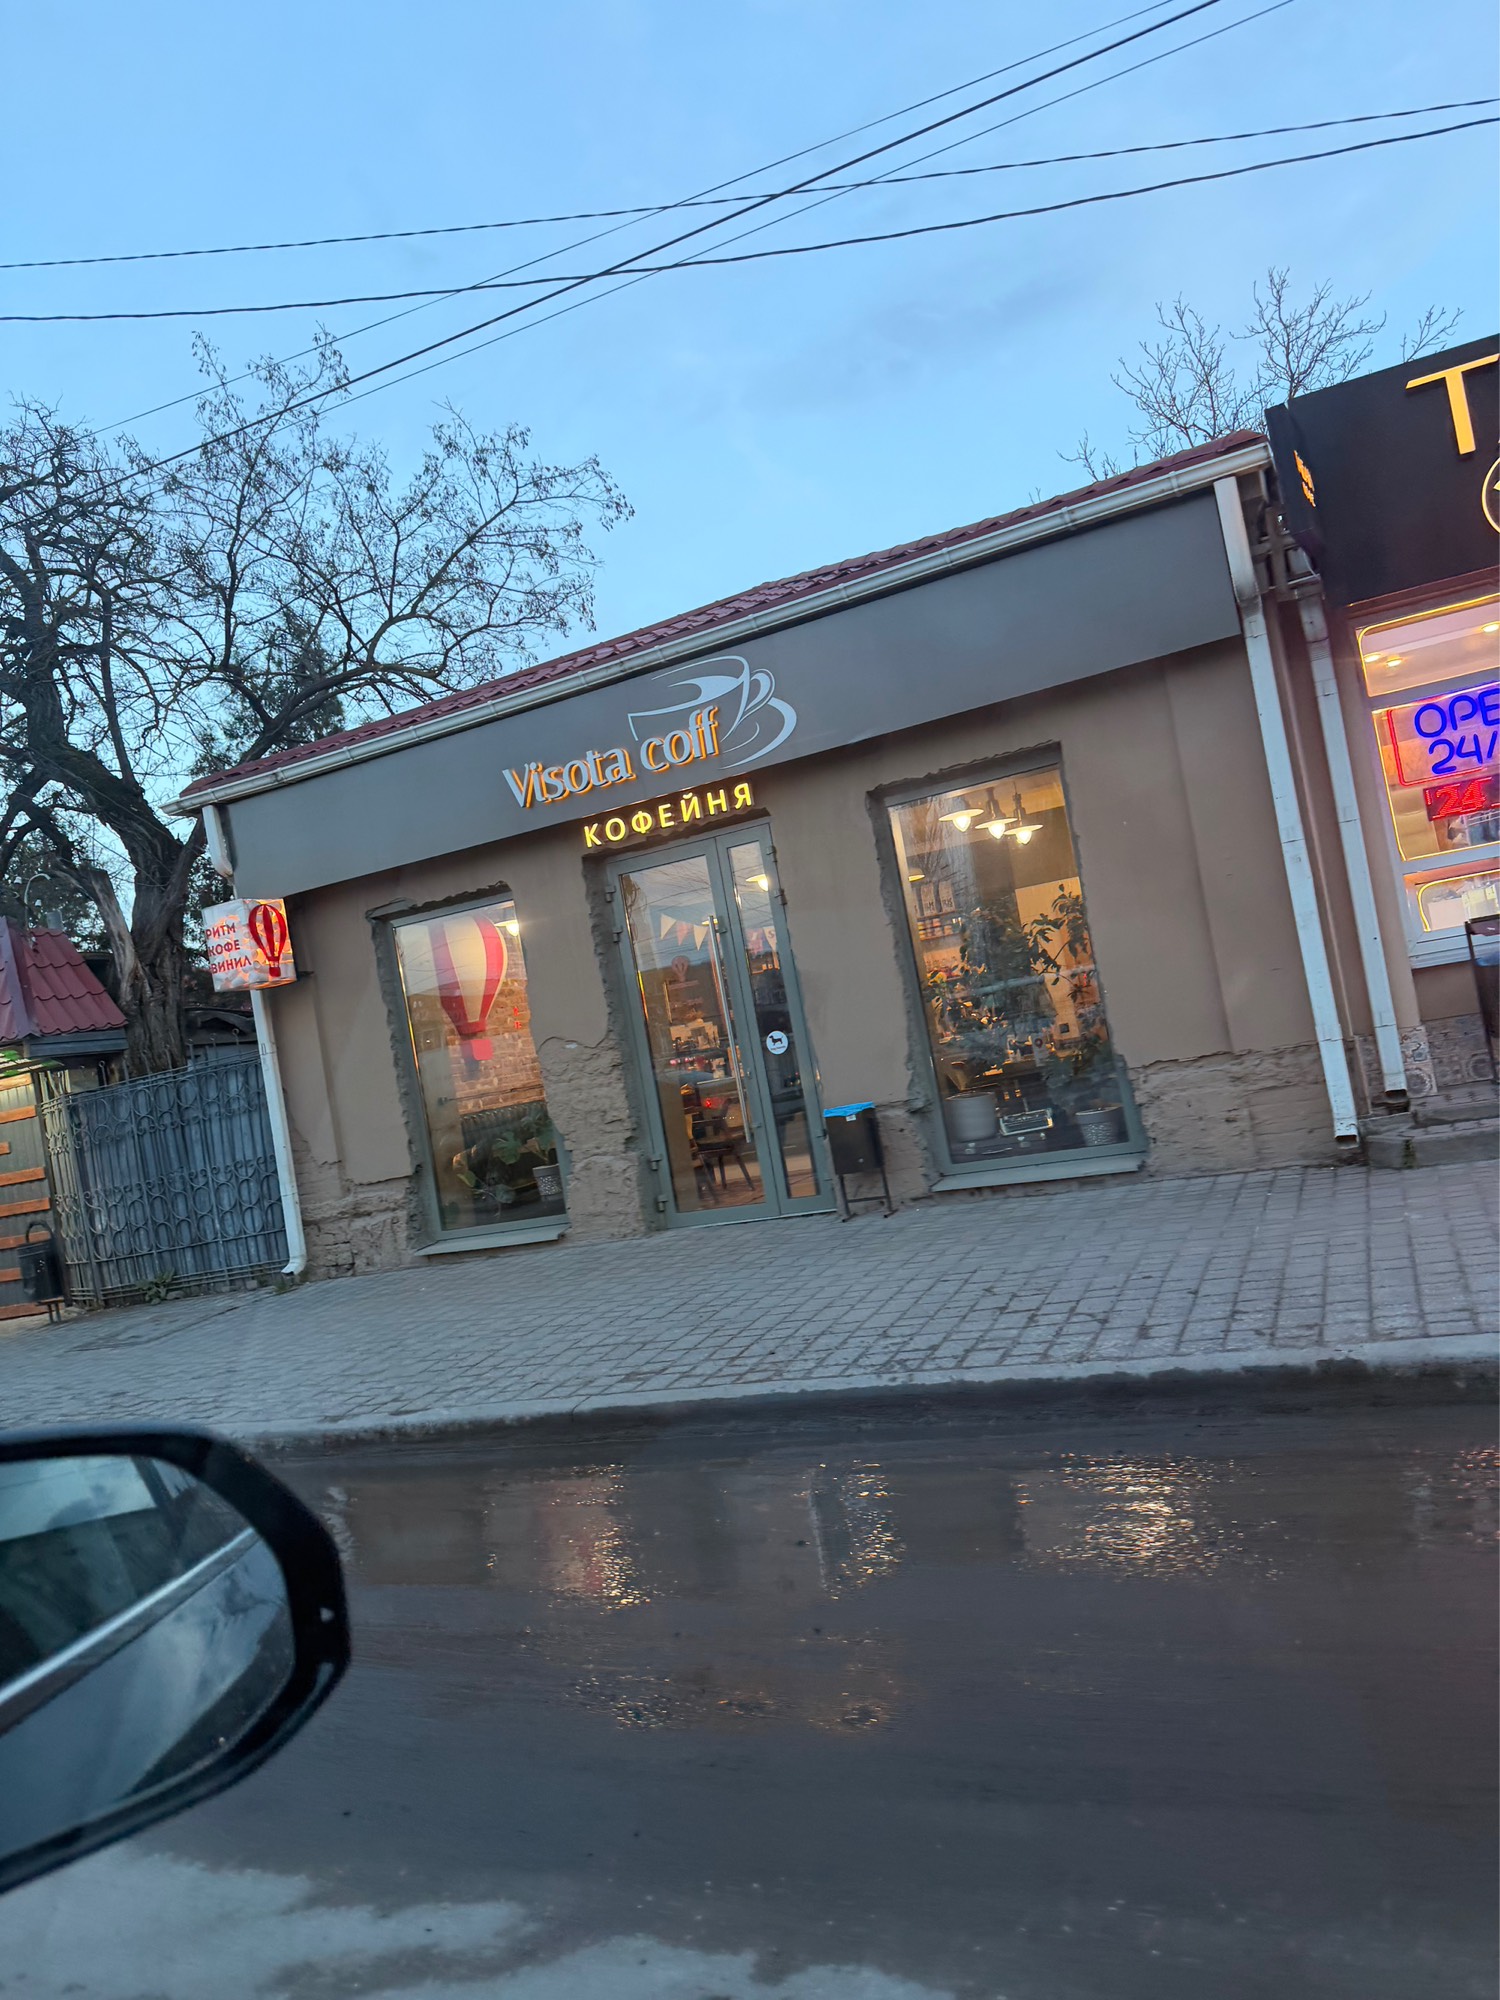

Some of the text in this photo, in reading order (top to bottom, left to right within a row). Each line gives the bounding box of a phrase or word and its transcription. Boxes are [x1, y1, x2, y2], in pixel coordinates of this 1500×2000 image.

[502, 705, 719, 808] Visota coff
[583, 782, 753, 848] КОФЕЙНЯ
[205, 922, 236, 940] РИТМ
[208, 939, 241, 957] КОФЕ
[210, 955, 252, 975] ВИНИЛ
